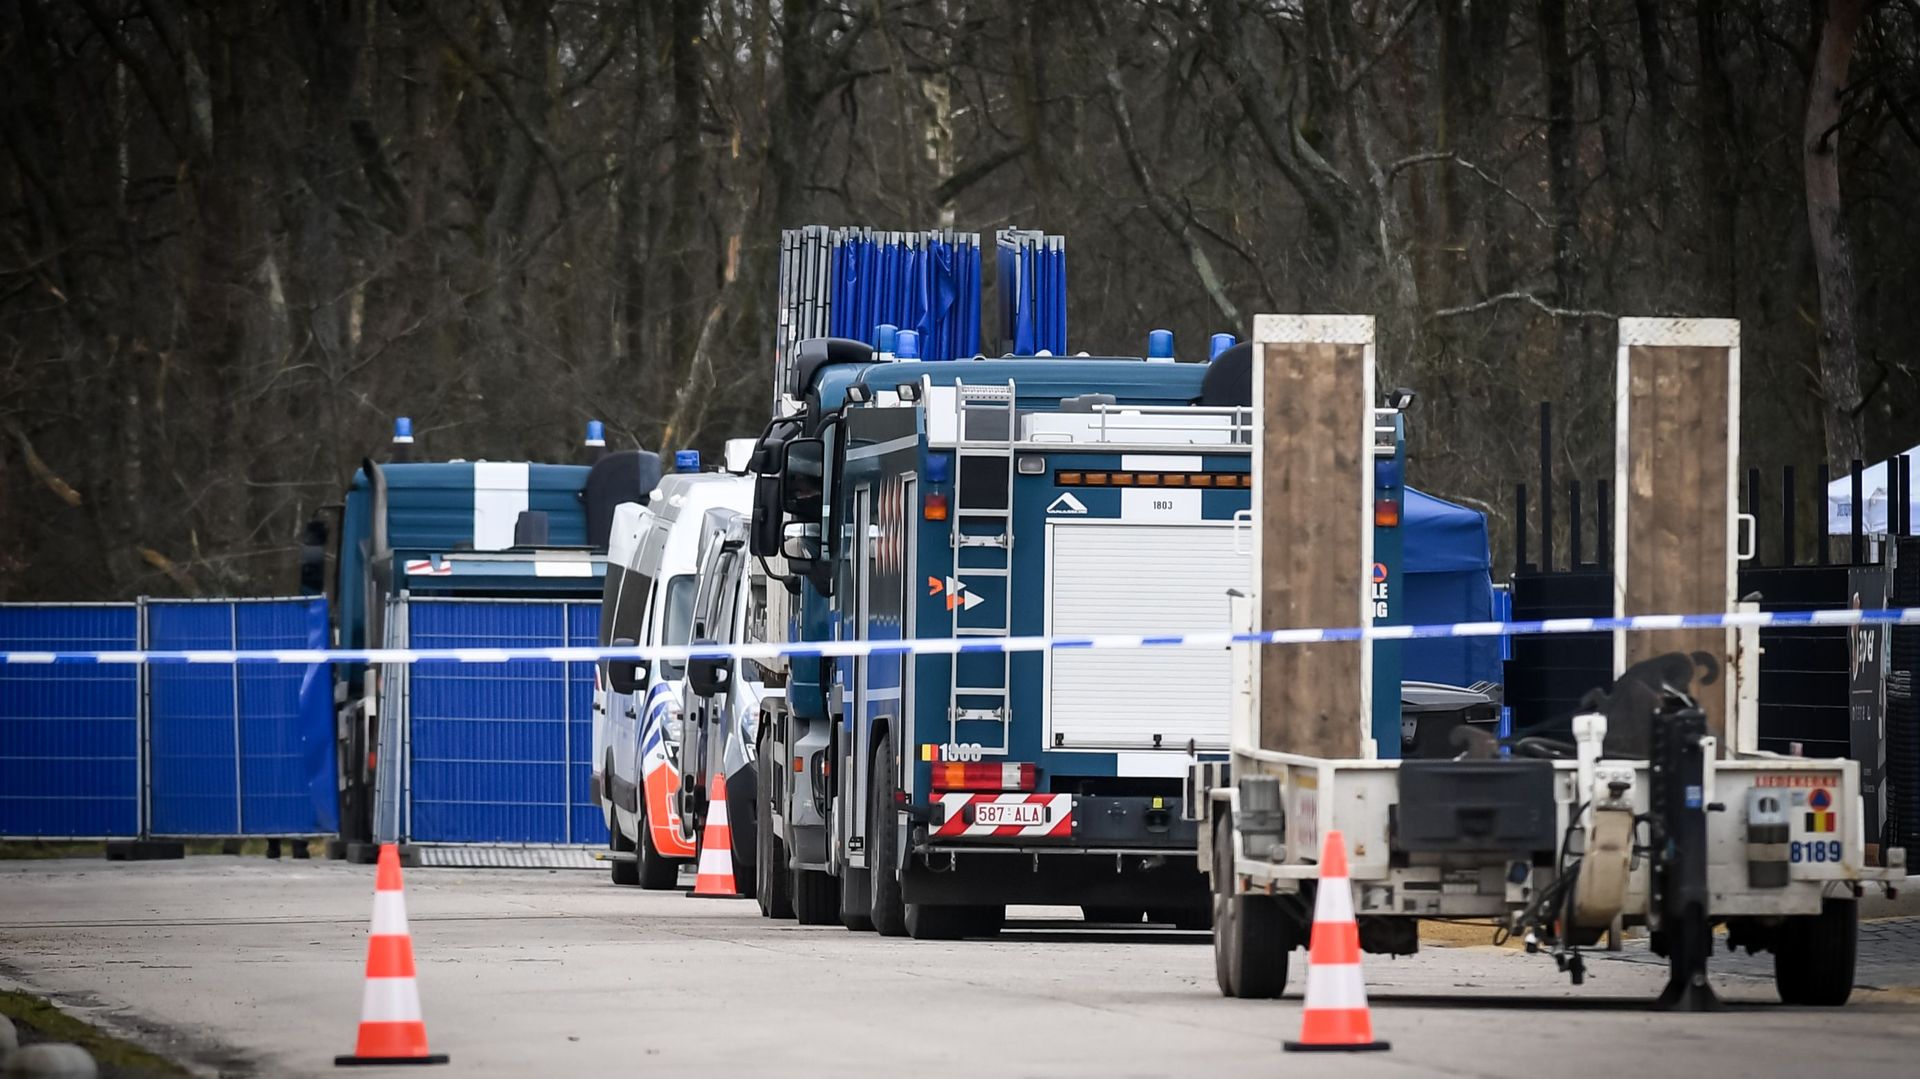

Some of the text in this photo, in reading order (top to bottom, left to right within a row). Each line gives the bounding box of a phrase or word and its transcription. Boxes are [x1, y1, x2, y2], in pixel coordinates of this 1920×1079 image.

[1153, 501, 1173, 510] 1803
[979, 806, 1039, 822] 587 ALA
[1790, 840, 1842, 864] 8189
